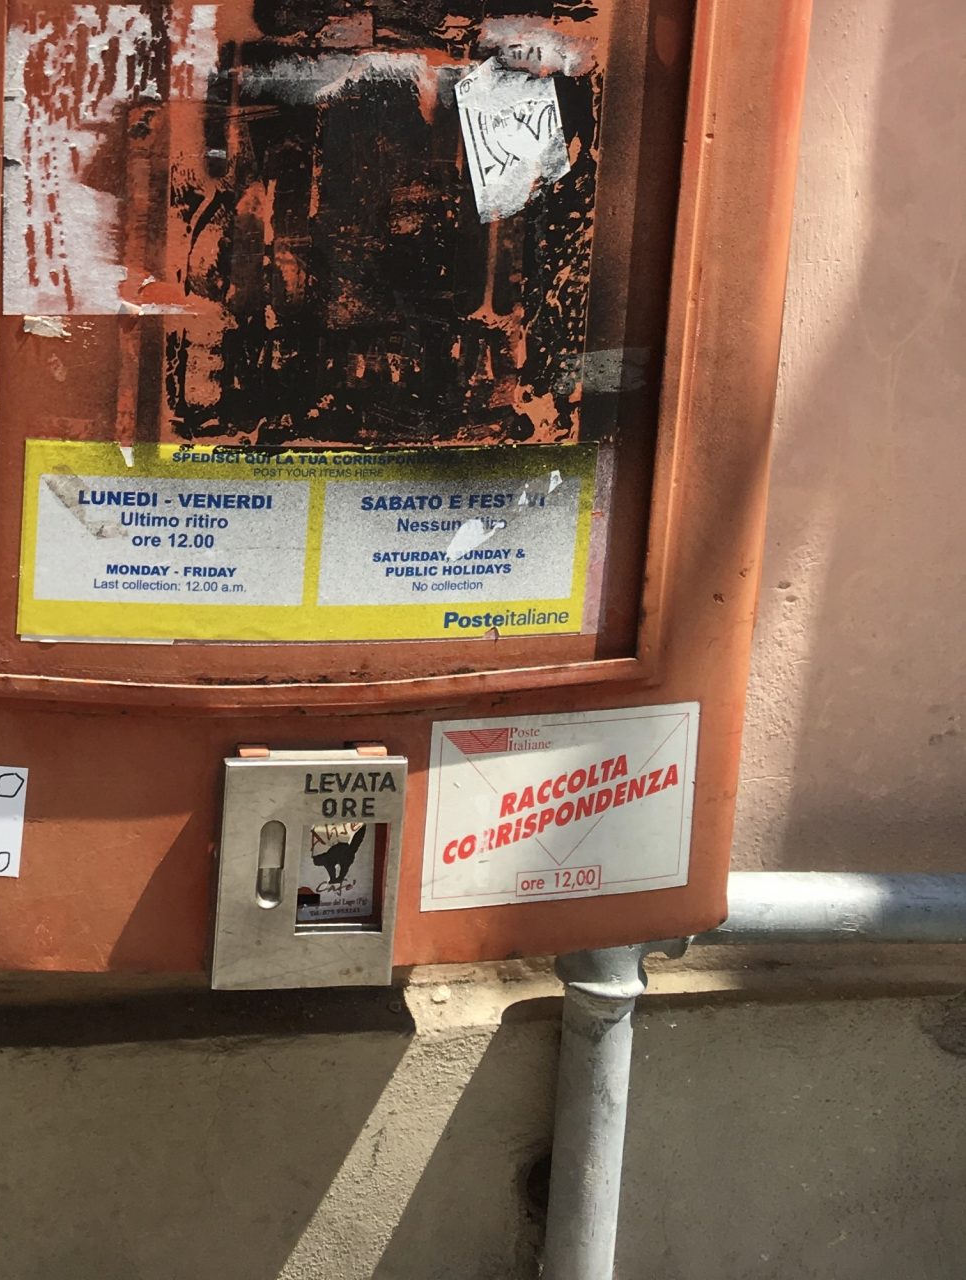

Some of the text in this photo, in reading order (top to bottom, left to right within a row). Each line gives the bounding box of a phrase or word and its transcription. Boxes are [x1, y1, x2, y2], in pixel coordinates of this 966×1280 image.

[172, 452, 239, 464] SPEDISCI
[245, 453, 270, 465] QUI
[276, 454, 293, 465] LA
[298, 455, 327, 465] TUA
[254, 468, 383, 477] POST YOUR ITEMS HERE
[78, 490, 157, 507] LUNEDI
[178, 494, 272, 509] VENERDI
[361, 493, 545, 511] SABATO E FESVI
[121, 512, 228, 529] Ultimo ritiro
[397, 518, 461, 532] Nessun
[132, 534, 214, 548] ore 12.00
[373, 548, 526, 563] SATURDAY, UNDAY &
[106, 564, 170, 576] MONDAY
[184, 567, 237, 578] FRIDAY
[386, 564, 512, 577] PUBLIC HOLIDAYS
[93, 579, 247, 592] Last collection: 12.00 a.m.
[412, 581, 483, 591] No collection
[443, 608, 569, 628] Posteitaliane
[509, 727, 540, 738] Poste
[509, 739, 552, 751] Italiane
[304, 772, 396, 794] LEVATA
[499, 754, 628, 818] RACCOLTA
[322, 798, 375, 818] ORE
[442, 764, 678, 865] CORRISPONDENZA
[521, 869, 595, 891] ore 12,00
